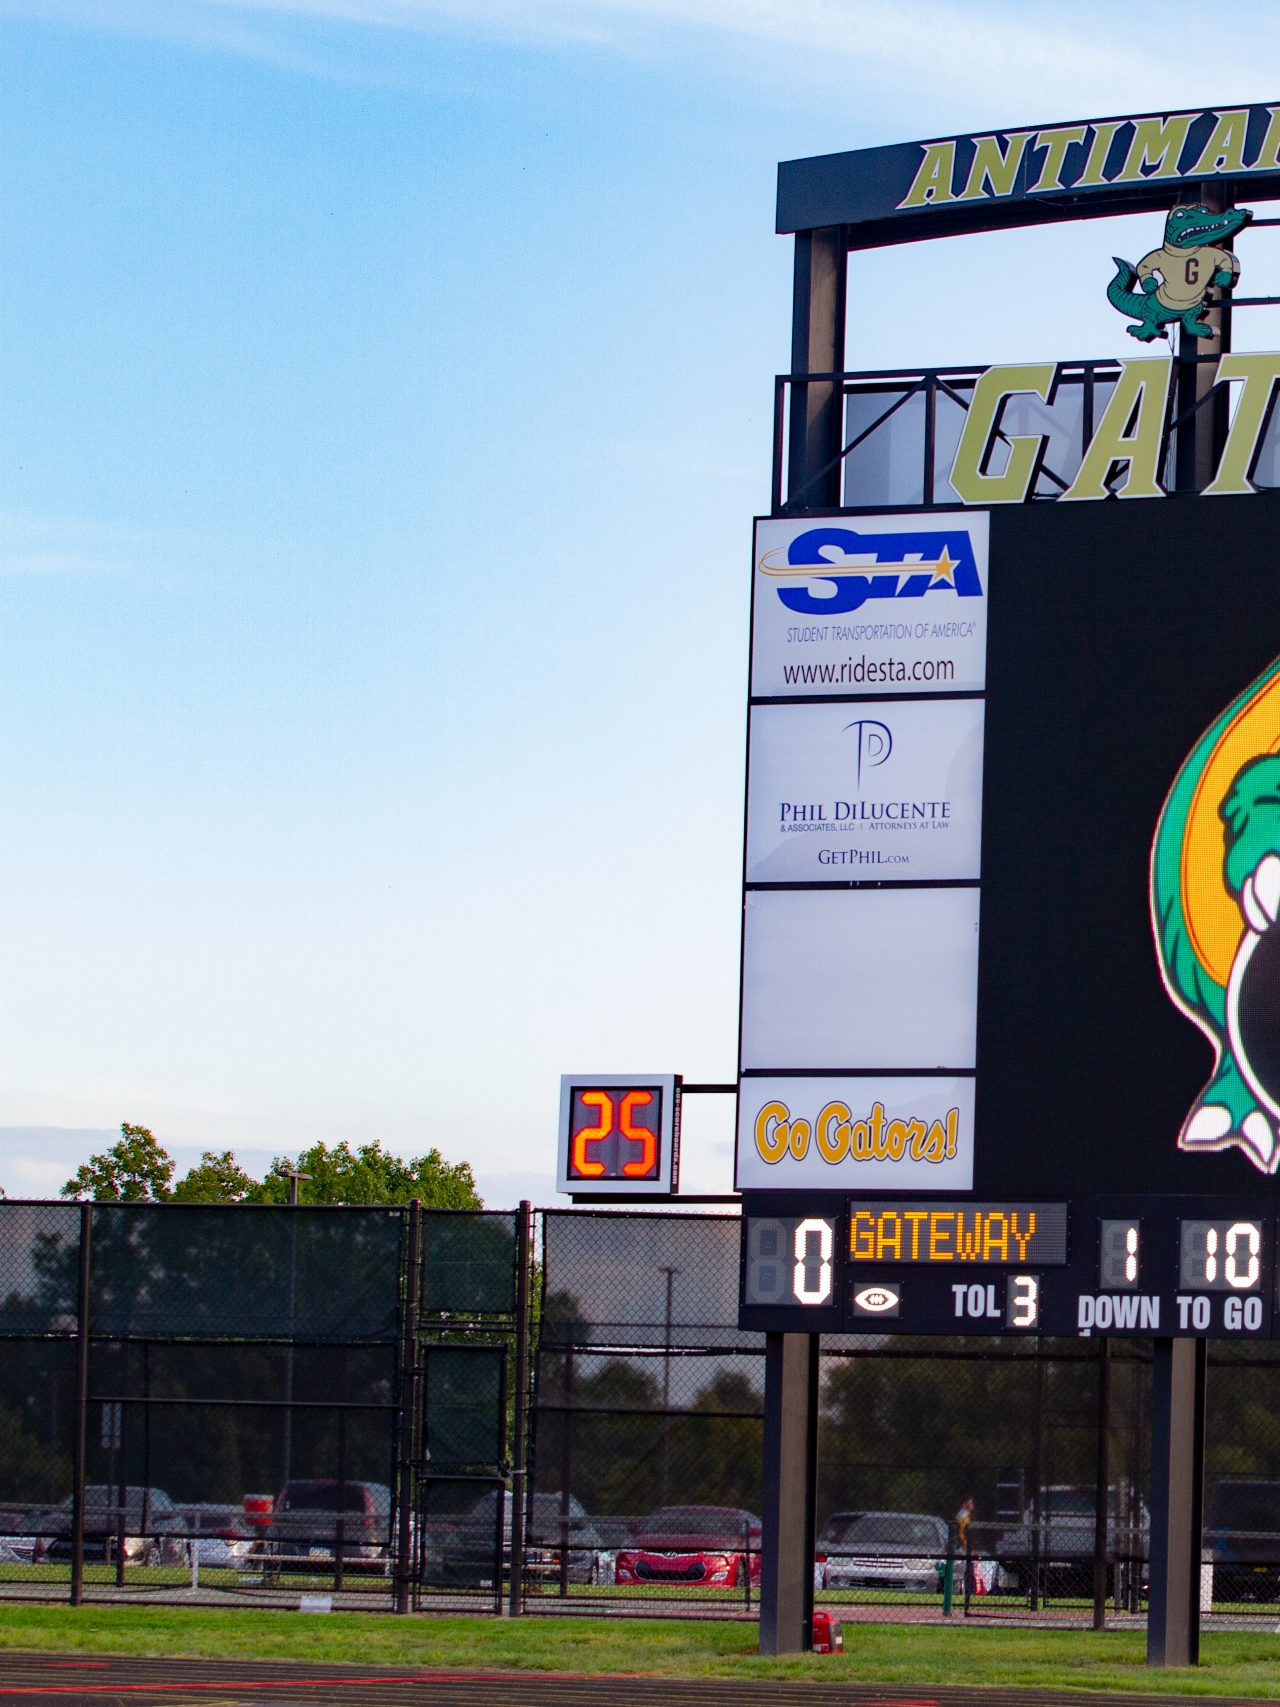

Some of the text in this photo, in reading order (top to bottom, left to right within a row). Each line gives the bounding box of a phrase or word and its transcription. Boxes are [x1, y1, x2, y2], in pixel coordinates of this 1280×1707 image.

[1184, 257, 1200, 286] G
[776, 527, 984, 615] STA
[787, 627, 829, 643] STUDENT
[832, 624, 912, 641] TRANSPORTATION
[915, 623, 929, 639] OF
[783, 655, 955, 685] www.ridesta.com
[780, 825, 786, 833] &
[787, 823, 838, 833] ASSOCIATES,
[839, 823, 855, 831] LLC
[573, 1090, 656, 1177] 25
[754, 1101, 960, 1165] Go Gators!
[850, 1210, 1036, 1260] GATEWAY
[1124, 1227, 1138, 1283] 1
[1205, 1221, 1261, 1289] 10
[793, 1217, 834, 1305] 0
[952, 1284, 1000, 1319] TOL
[1012, 1275, 1038, 1327] 3
[1077, 1294, 1160, 1330] DOWN
[1176, 1296, 1263, 1331] TO GO
